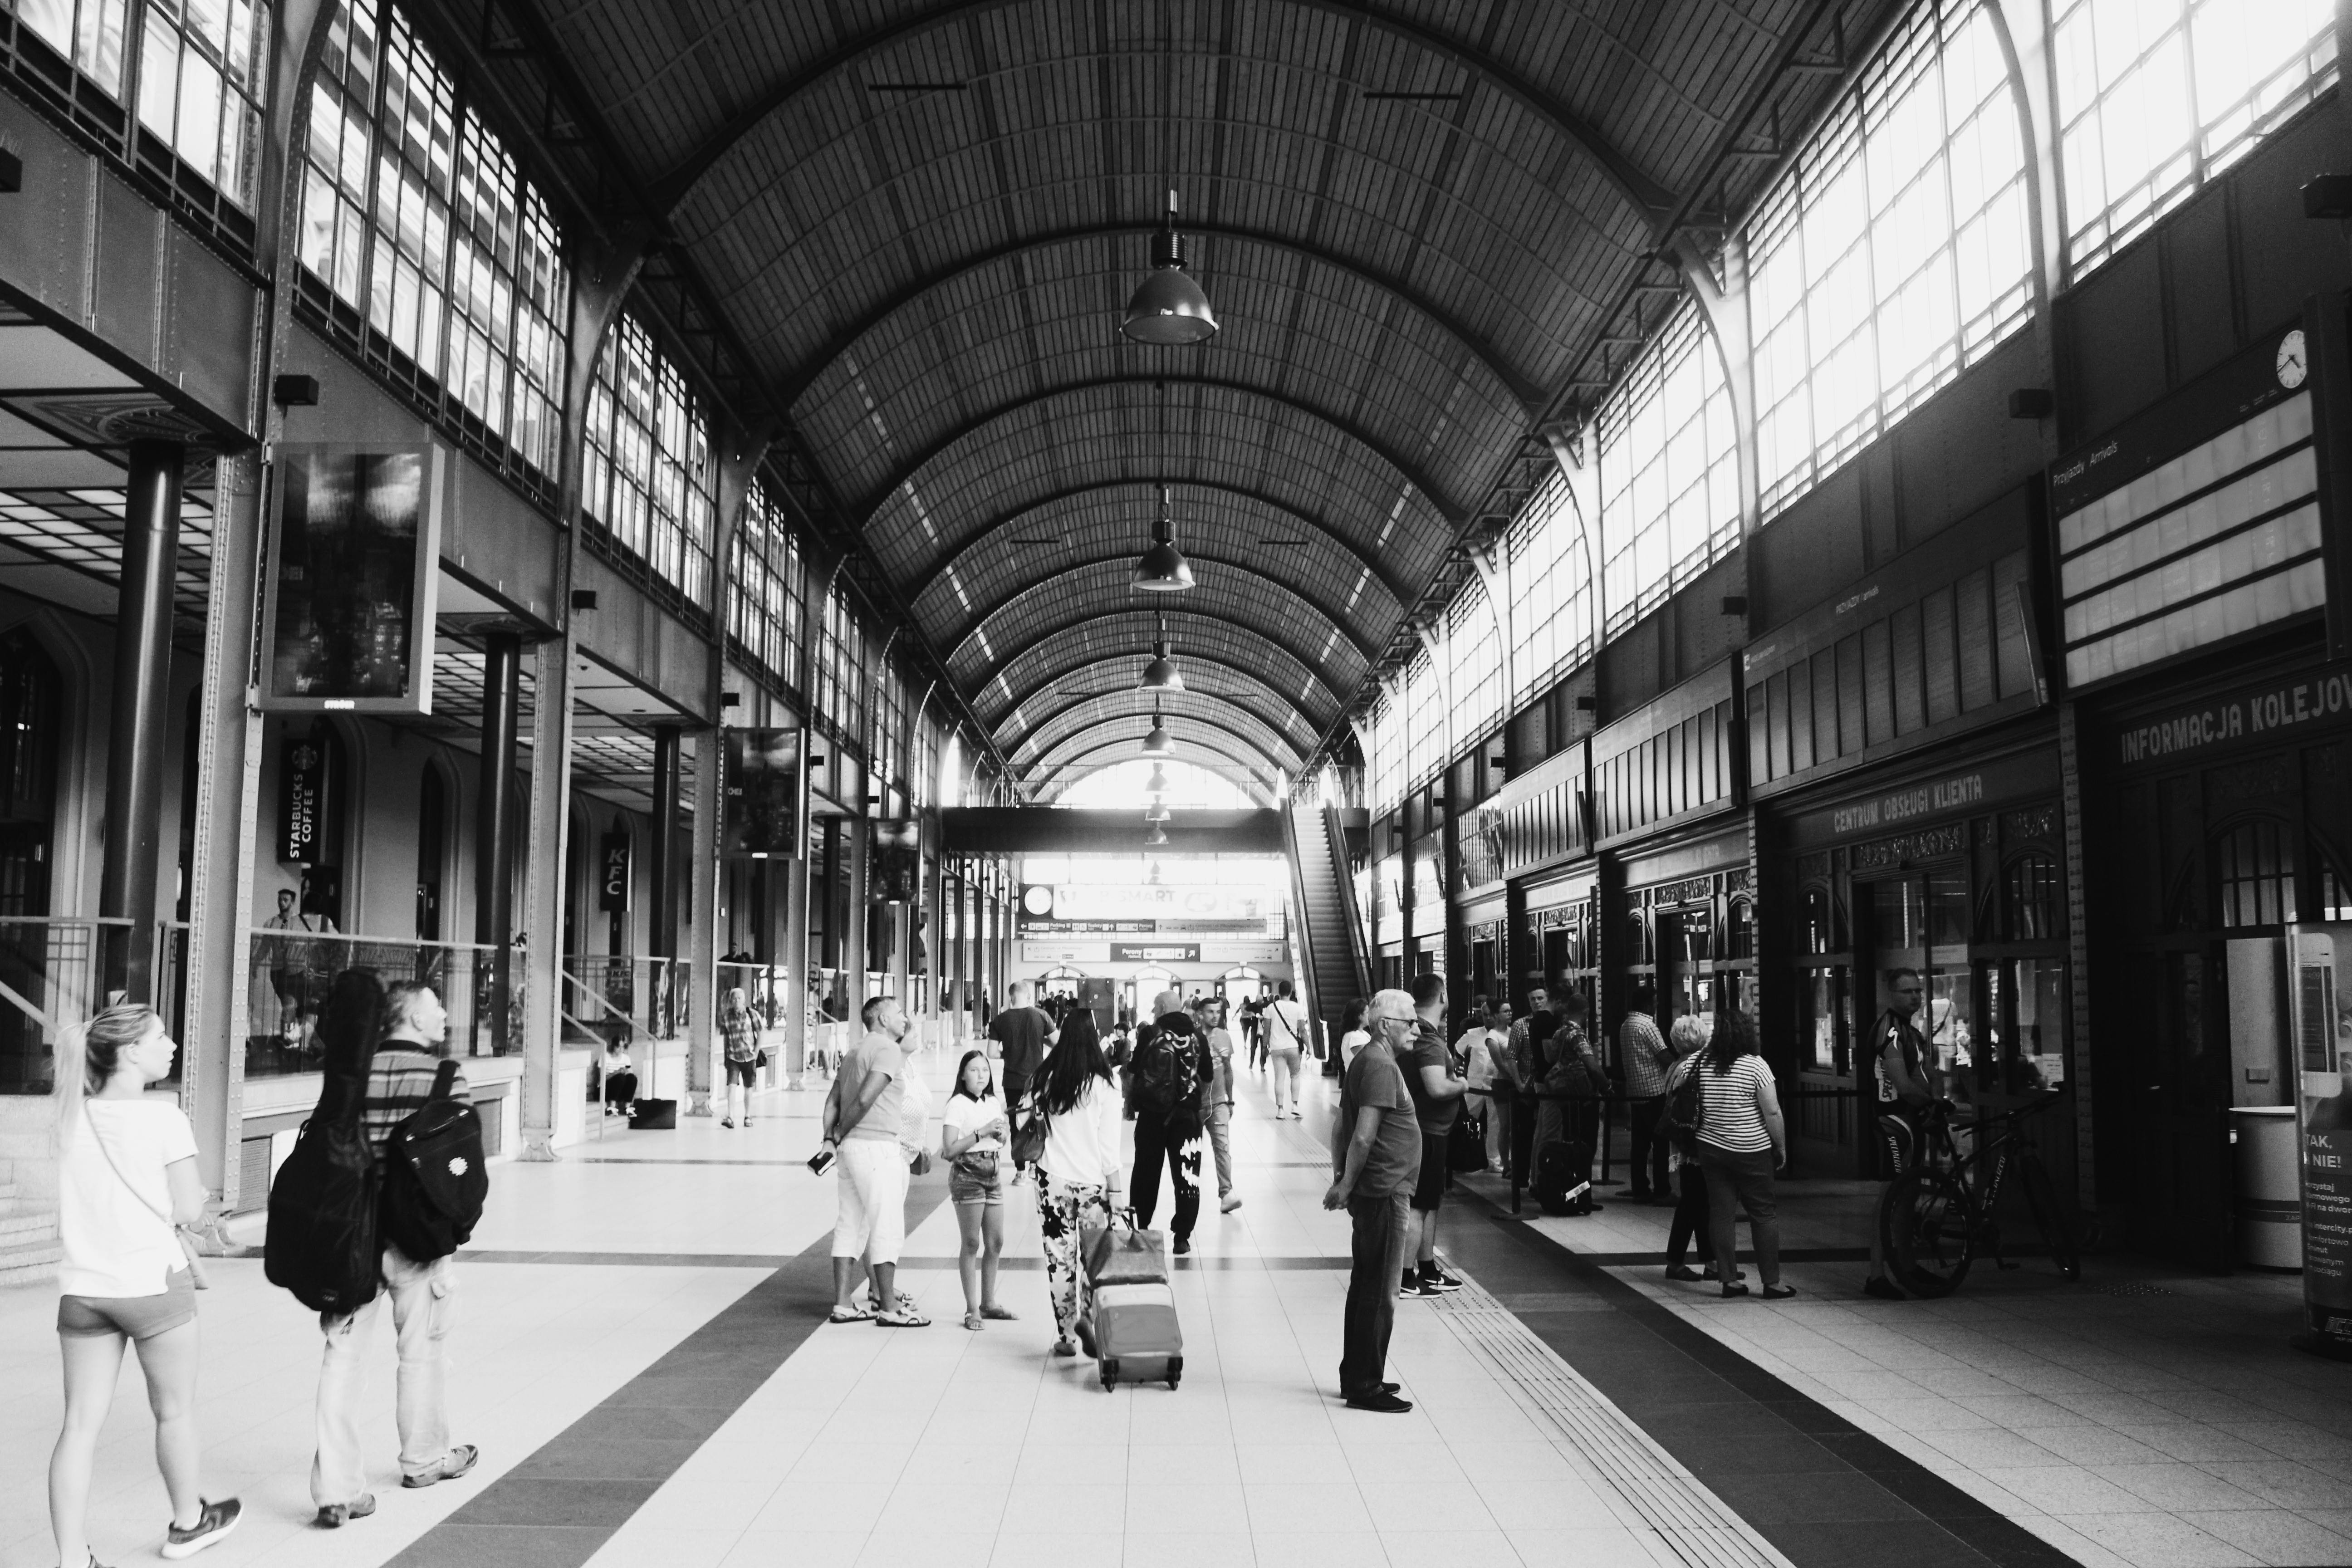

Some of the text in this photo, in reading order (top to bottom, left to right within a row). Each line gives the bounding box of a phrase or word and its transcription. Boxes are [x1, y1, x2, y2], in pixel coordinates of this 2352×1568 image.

[2089, 440, 2118, 467] Arrivals
[2121, 703, 2244, 764] INFORMACJA
[289, 773, 304, 859] STARBUCKS
[302, 787, 314, 844] COFFEE
[1833, 774, 1983, 833] CENTRUM OBSŁUGI KLIENTA
[606, 848, 627, 896] KFC
[1118, 889, 1176, 902] SMART
[2312, 1153, 2342, 1169] NIE!
